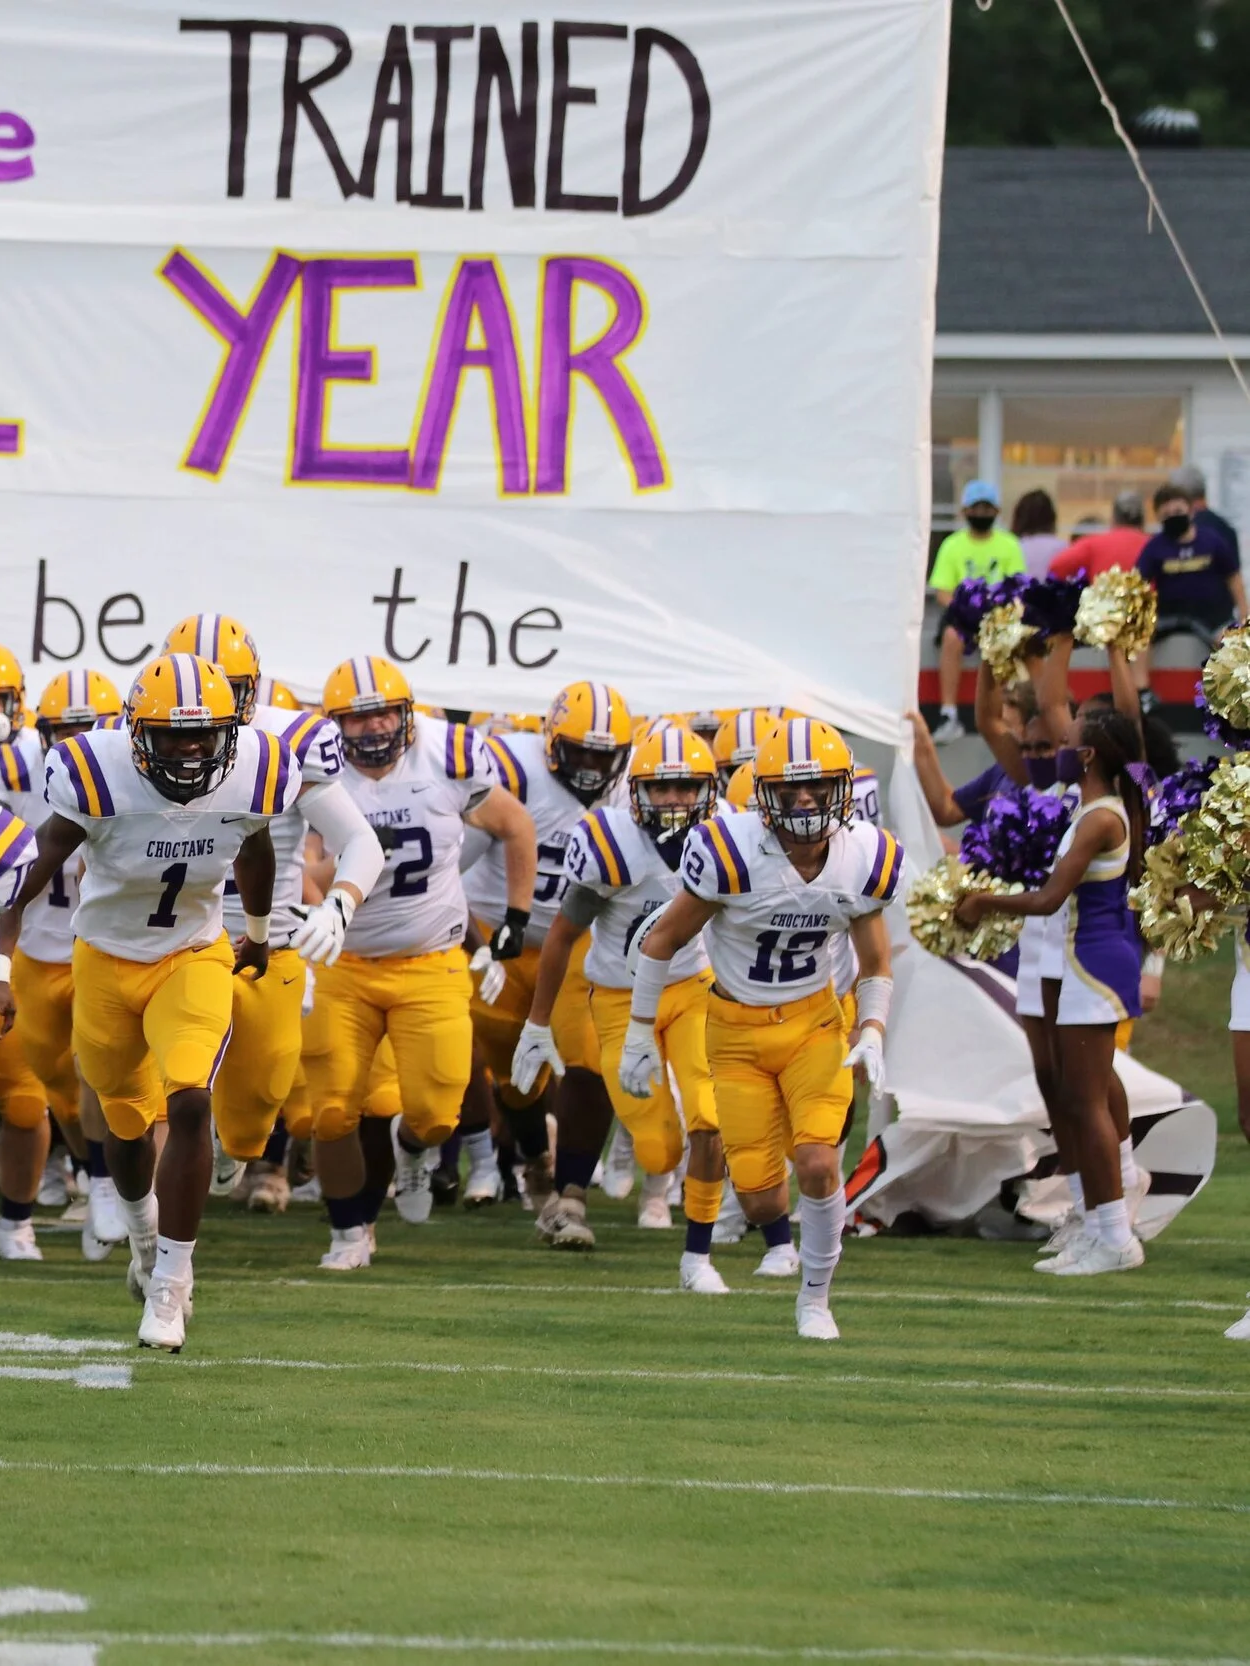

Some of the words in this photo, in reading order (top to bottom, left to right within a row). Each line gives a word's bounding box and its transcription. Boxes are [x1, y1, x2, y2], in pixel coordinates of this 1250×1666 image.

[180, 19, 710, 217] TRAINED
[154, 245, 672, 499] YEAR
[31, 558, 154, 666] be
[373, 561, 563, 669] the
[179, 708, 203, 716] Riddell
[146, 838, 214, 859] CHOCTAWS
[364, 808, 411, 830] OCTAWS
[390, 827, 433, 897] 2
[147, 863, 188, 928] 1
[770, 913, 830, 929] CHOCTAWS
[748, 930, 828, 983] 12
